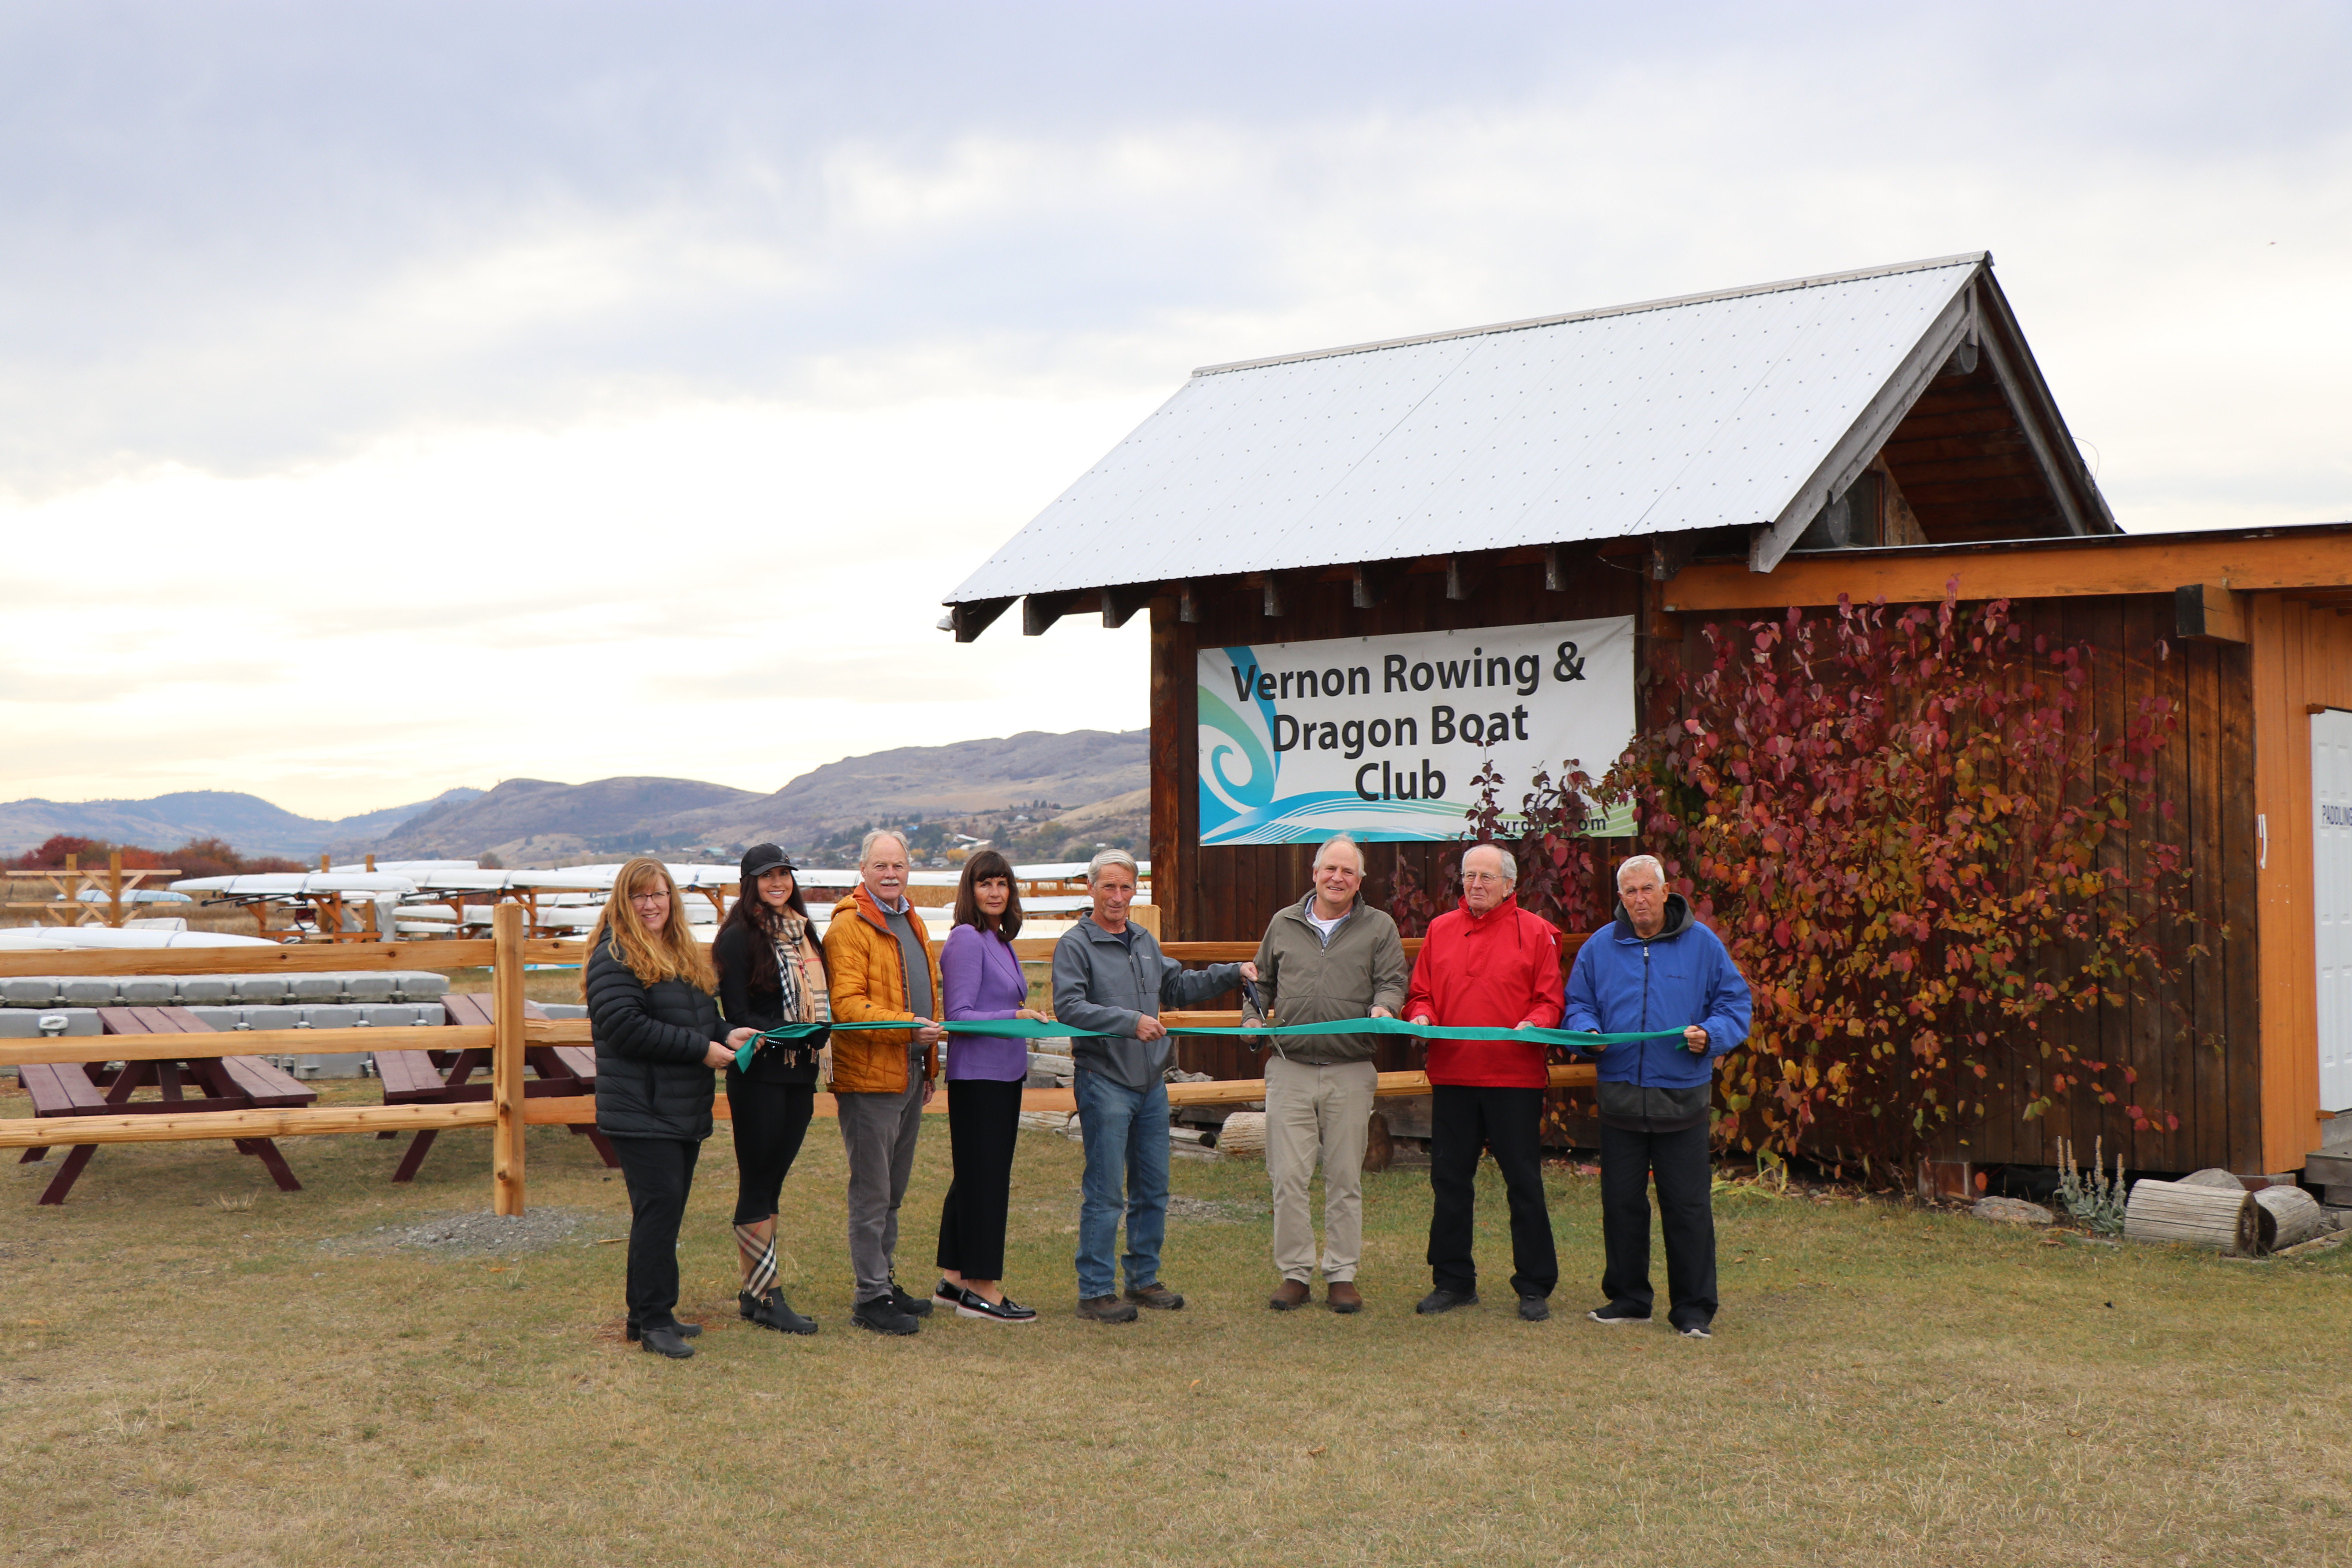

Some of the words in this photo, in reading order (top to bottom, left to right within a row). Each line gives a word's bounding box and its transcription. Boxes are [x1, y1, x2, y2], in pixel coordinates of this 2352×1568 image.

[1230, 665, 1370, 702] Vernon
[1384, 647, 1539, 696] Rowing
[1553, 641, 1586, 682] &
[1273, 714, 1417, 759] Dragon
[1432, 704, 1528, 747] Boat
[1356, 759, 1446, 801] Club
